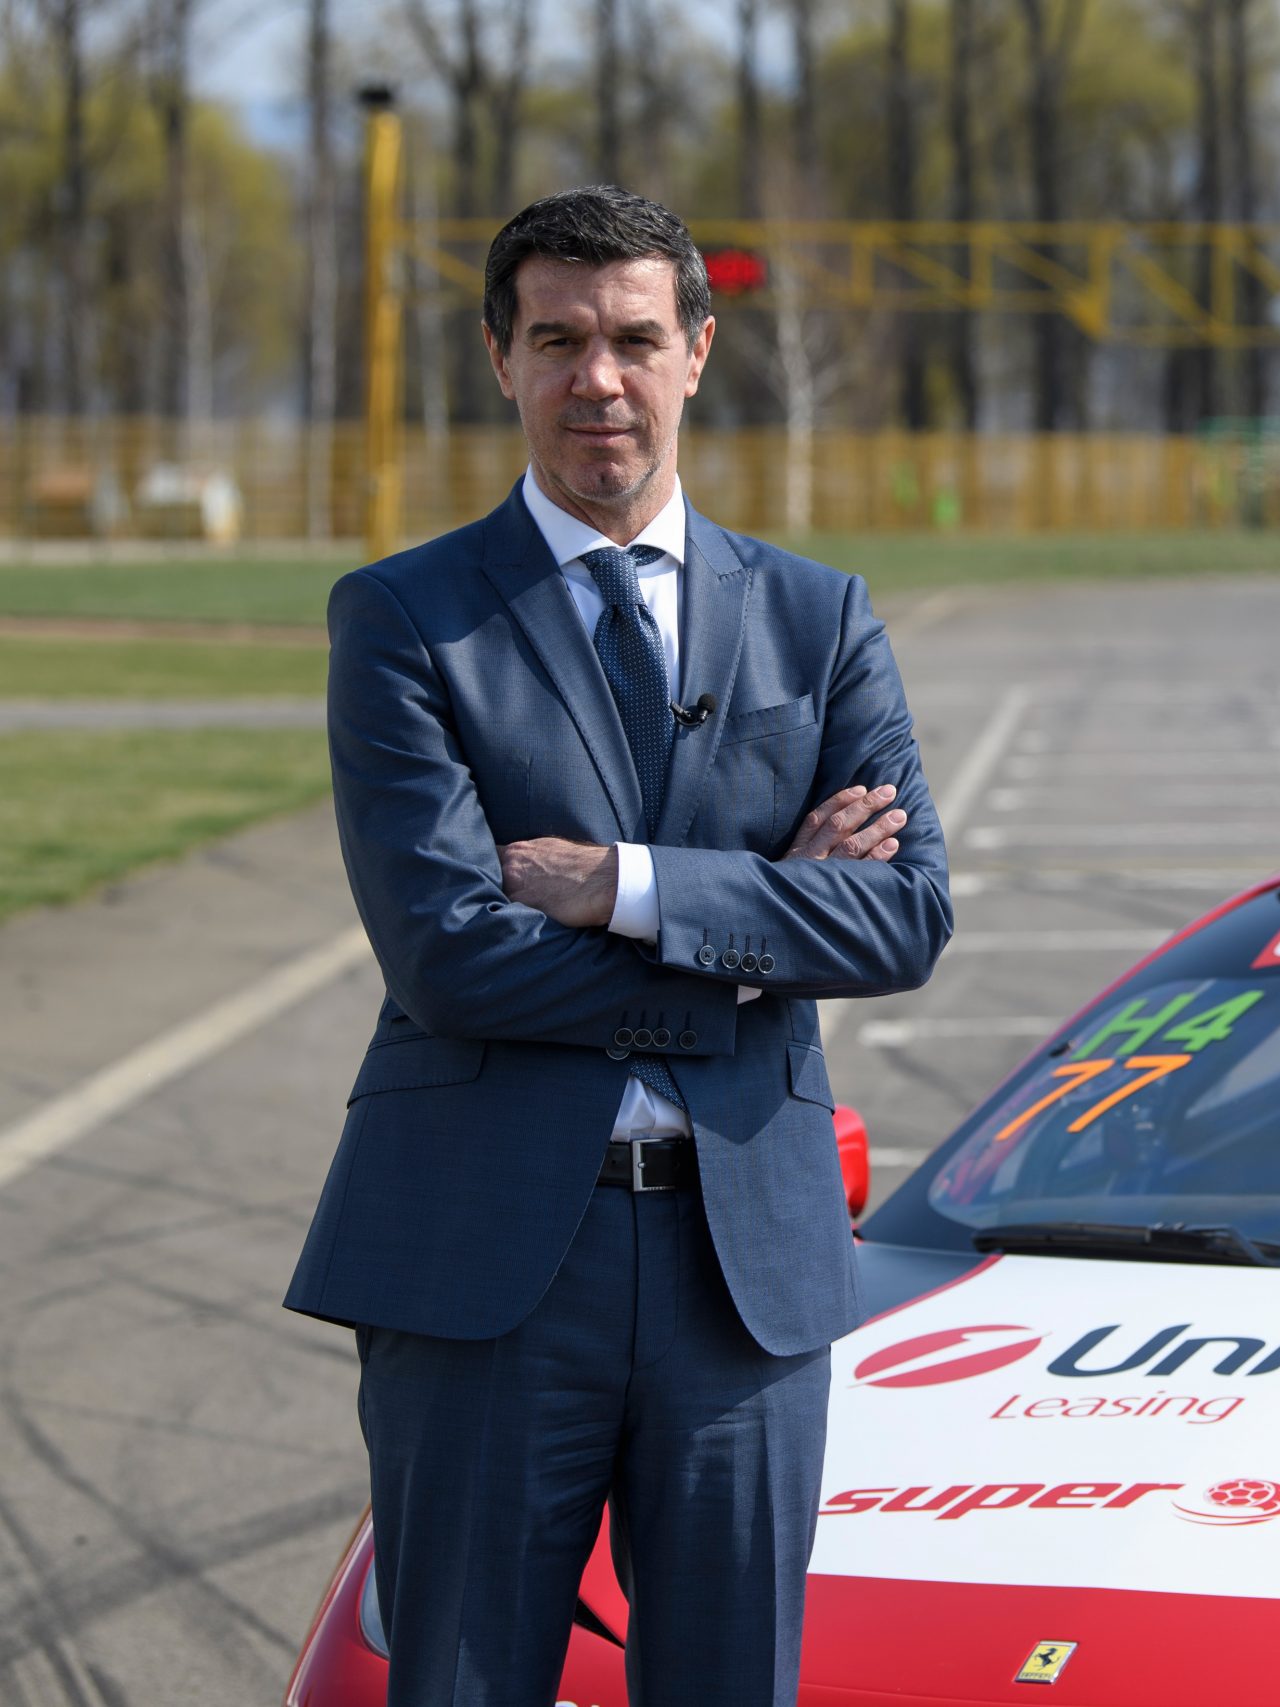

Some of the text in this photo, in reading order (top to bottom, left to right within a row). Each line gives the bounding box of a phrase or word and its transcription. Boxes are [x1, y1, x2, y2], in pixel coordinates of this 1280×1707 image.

[1071, 990, 1264, 1061] H4
[995, 1054, 1192, 1141] 77
[990, 1390, 1246, 1425] Leasing
[818, 1482, 1186, 1521] super
